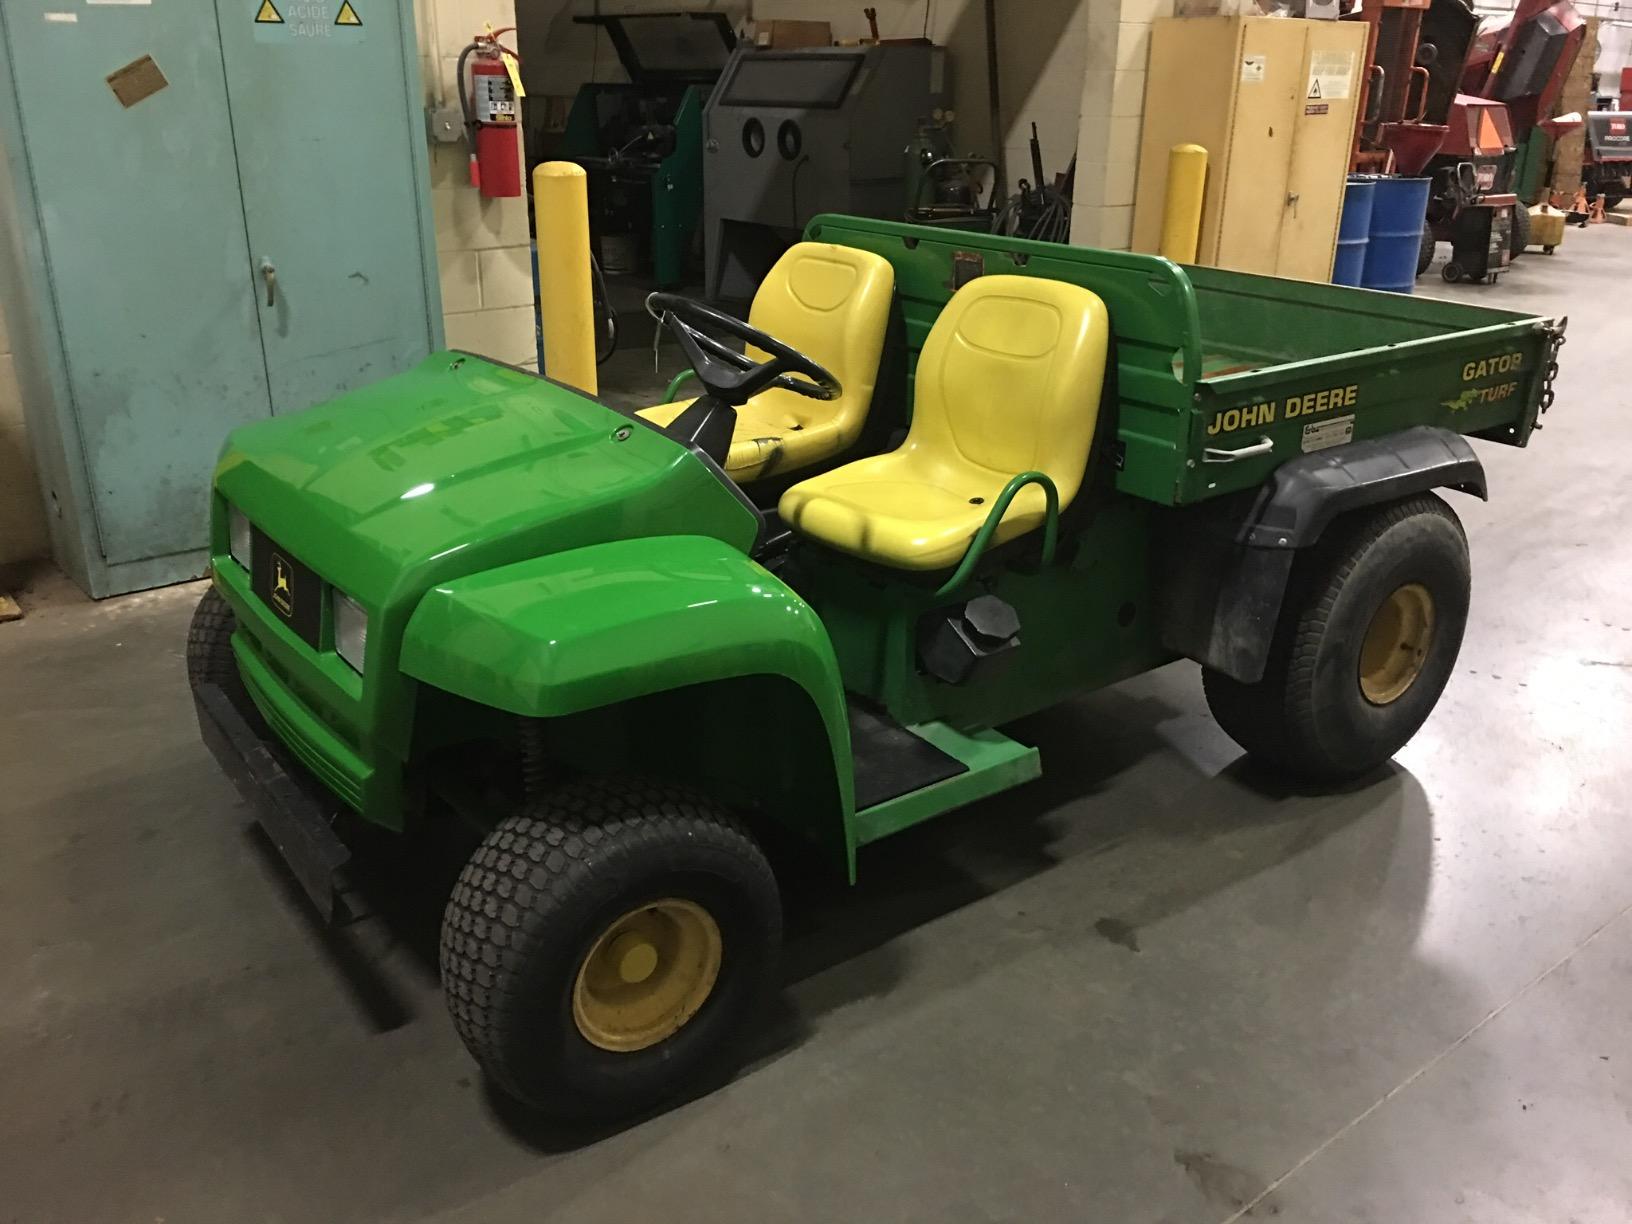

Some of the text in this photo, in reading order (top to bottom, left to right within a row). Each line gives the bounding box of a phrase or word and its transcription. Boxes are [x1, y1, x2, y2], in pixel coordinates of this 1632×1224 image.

[289, 5, 330, 19] ACIDE
[1462, 353, 1522, 381] GATOR
[1480, 382, 1518, 404] TURF
[1207, 385, 1358, 435] JOHN DEERE
